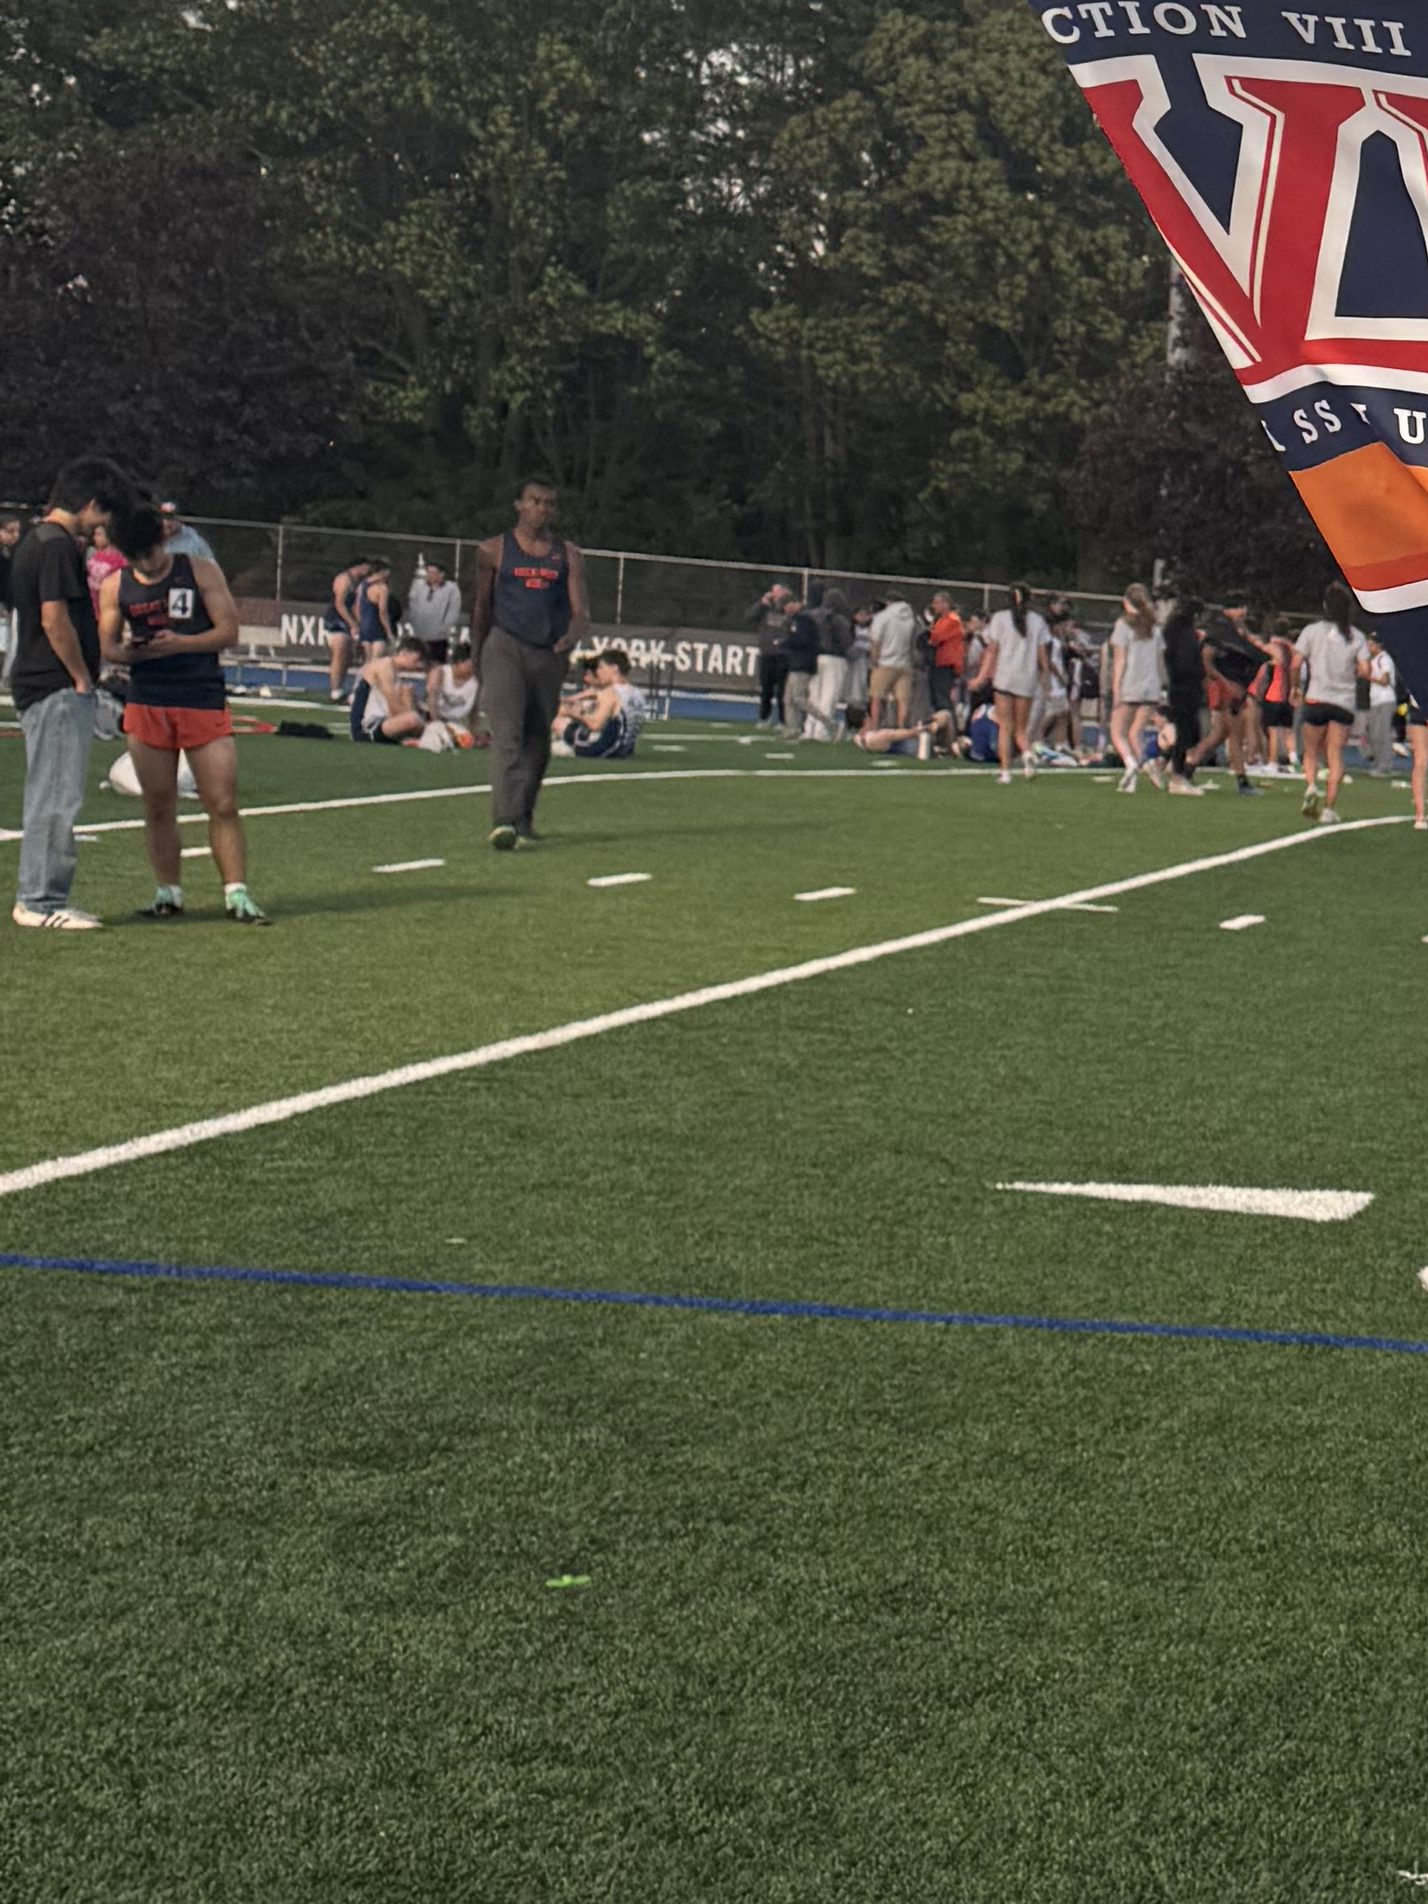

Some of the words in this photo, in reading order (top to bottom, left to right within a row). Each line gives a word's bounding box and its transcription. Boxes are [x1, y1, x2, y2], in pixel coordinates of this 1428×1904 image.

[1280, 10, 1412, 57] VIII
[1260, 398, 1427, 453] SSU
[172, 590, 189, 616] 4
